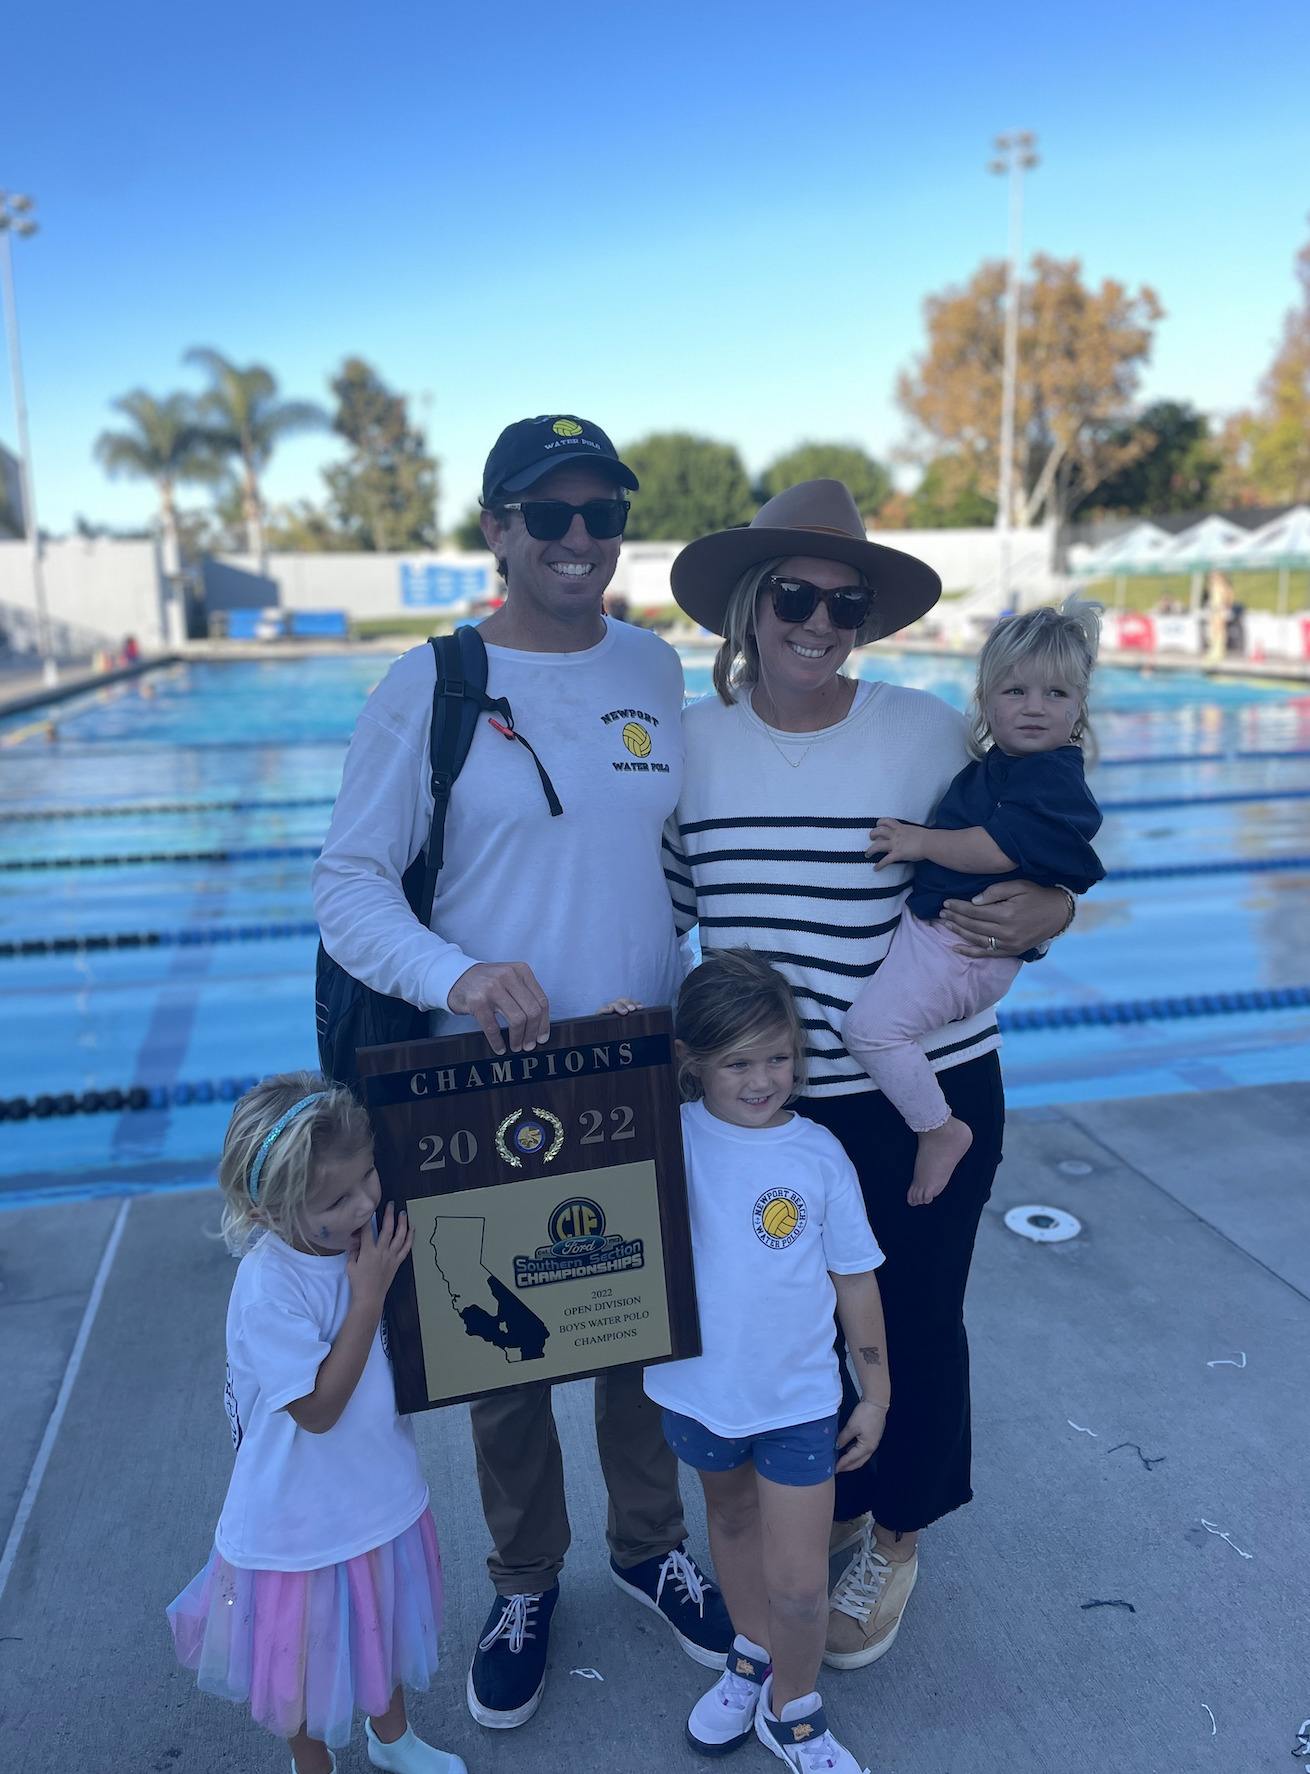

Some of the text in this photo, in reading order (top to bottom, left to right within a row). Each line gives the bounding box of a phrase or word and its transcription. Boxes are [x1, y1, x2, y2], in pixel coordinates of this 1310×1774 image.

[544, 438, 601, 450] WATER POLO
[600, 709, 660, 728] NEWPORT
[612, 762, 670, 773] WATER POLO
[410, 1042, 634, 1096] CHAMPIONS
[418, 1105, 636, 1172] 20 22
[755, 1189, 806, 1221] NEWPORT BEACH
[556, 1204, 598, 1240] CIF
[562, 1238, 596, 1255] Ford
[756, 1225, 800, 1248] WATER POLO
[515, 1241, 642, 1273] Southern Section
[516, 1253, 643, 1287] CHAMPIONSHIPS
[591, 1288, 614, 1300] 2022
[564, 1296, 642, 1317] OPEN DIVISION
[559, 1310, 650, 1334] BOYS WATER POLO
[574, 1328, 638, 1347] CHAMPIONS
